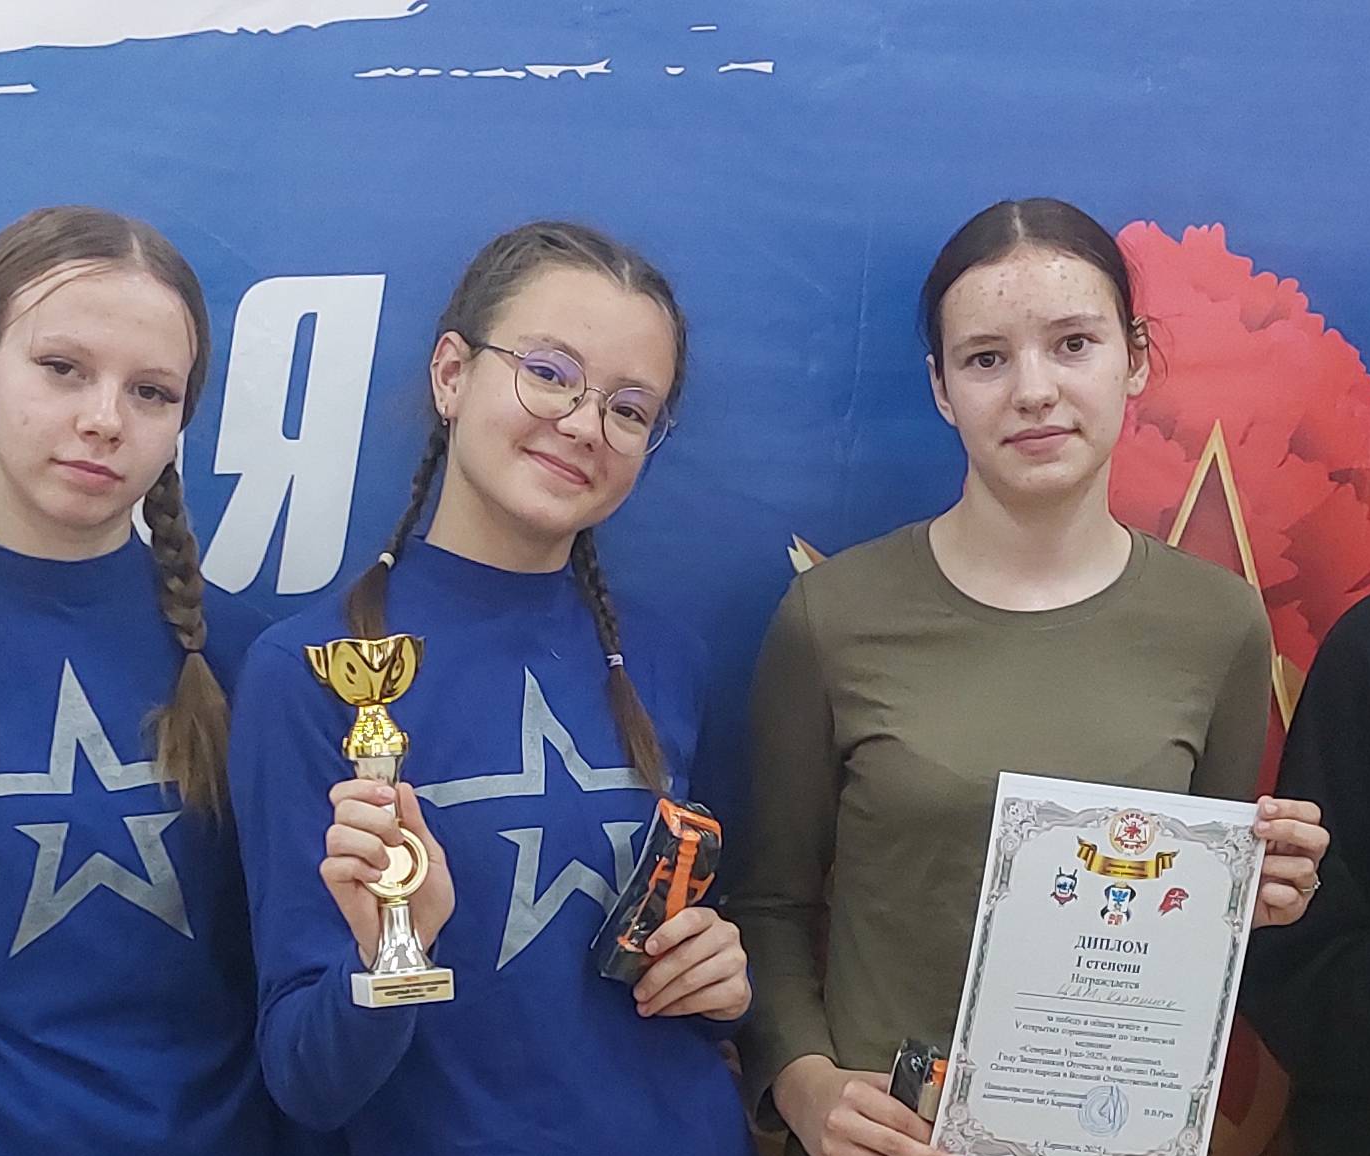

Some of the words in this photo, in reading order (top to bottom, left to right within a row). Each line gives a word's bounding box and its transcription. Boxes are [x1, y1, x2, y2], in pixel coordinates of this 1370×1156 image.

[1074, 935, 1149, 954] ДИПЛОМ
[1086, 959, 1141, 974] степени
[1071, 973, 1140, 990] Награждается
